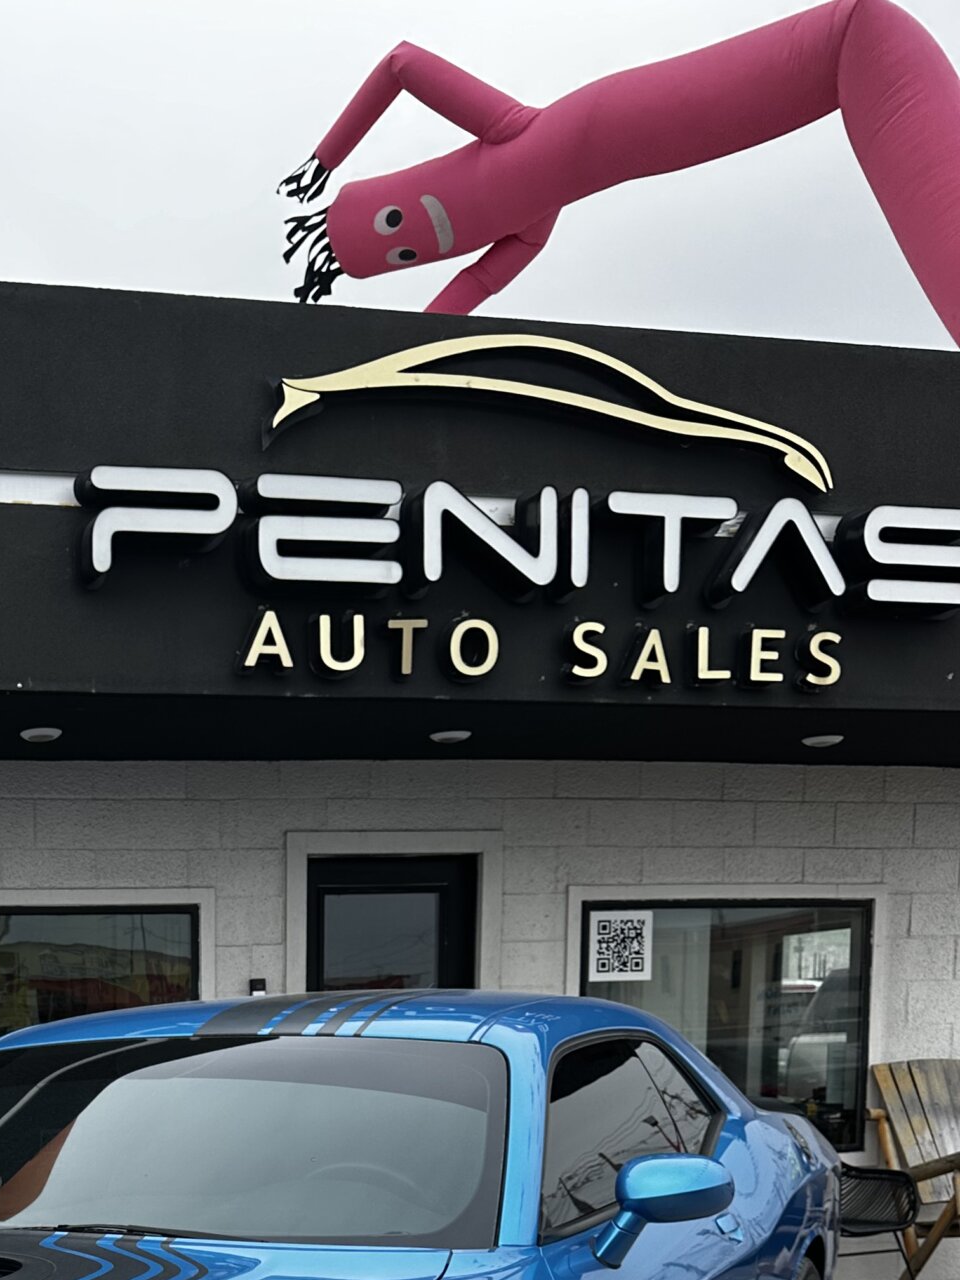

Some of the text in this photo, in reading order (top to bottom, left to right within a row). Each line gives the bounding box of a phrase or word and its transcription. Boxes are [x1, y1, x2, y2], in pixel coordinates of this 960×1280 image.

[89, 465, 960, 606] PENITAS
[243, 609, 843, 686] AUTO SALES
